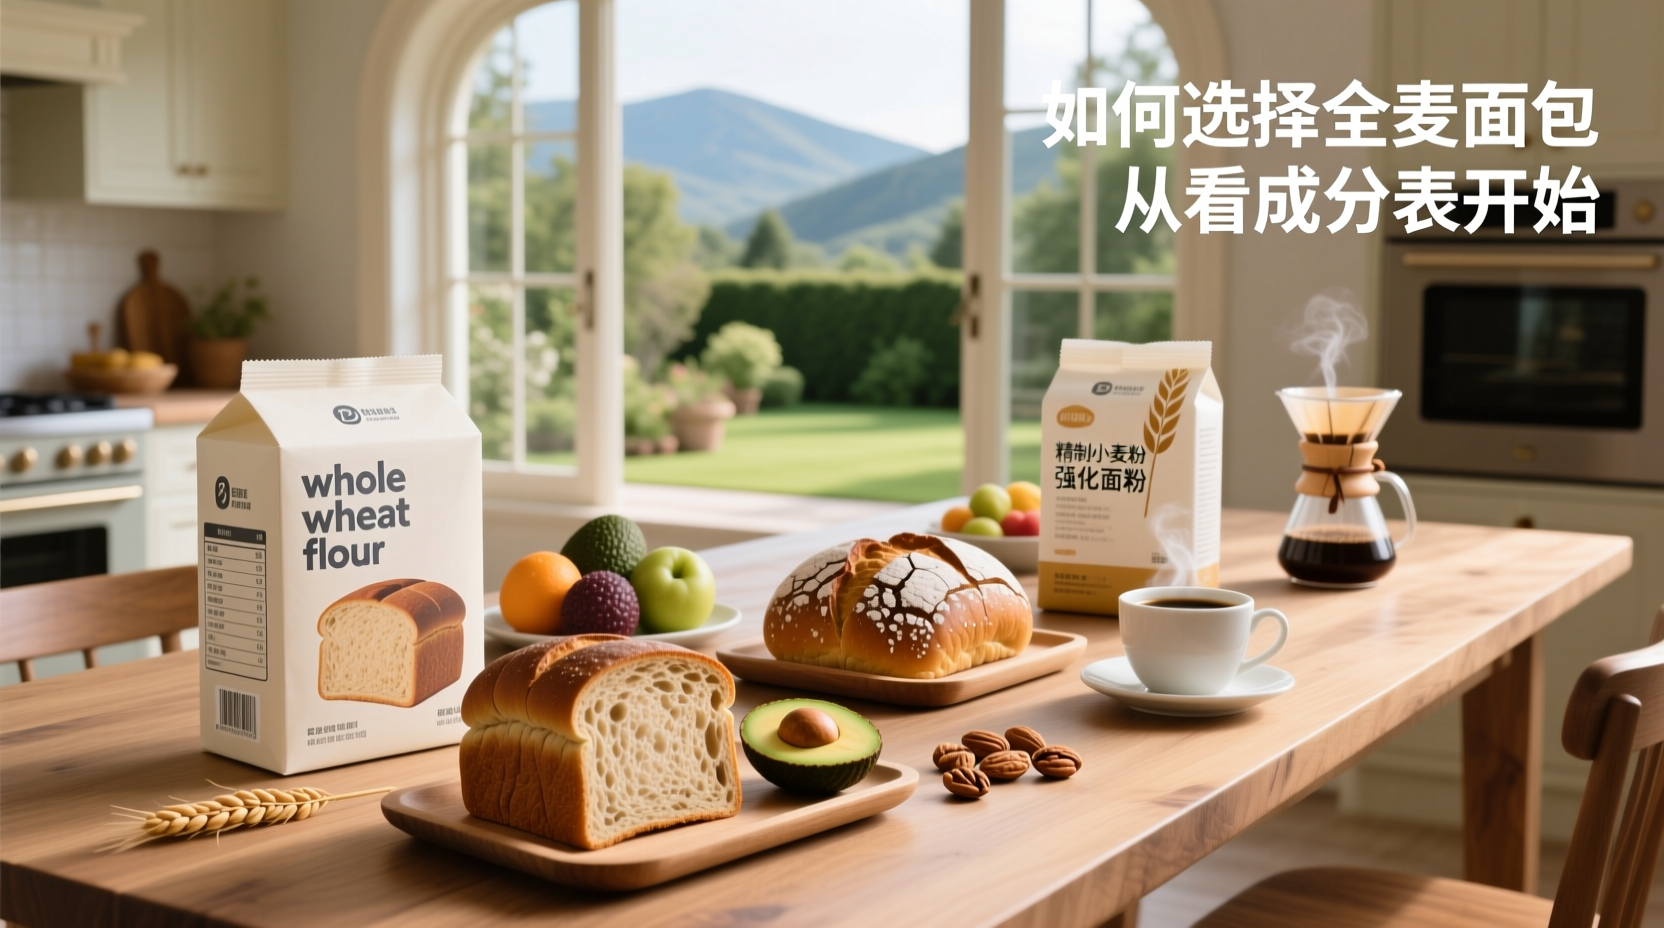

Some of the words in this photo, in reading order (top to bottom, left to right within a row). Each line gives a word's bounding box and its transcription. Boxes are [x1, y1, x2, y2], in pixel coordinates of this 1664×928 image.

[1055, 441, 1146, 464] 精制小麦粉
[301, 460, 406, 498] whole
[1055, 466, 1146, 493] 强化面粉
[301, 498, 410, 534] wheat
[303, 537, 385, 571] flour
